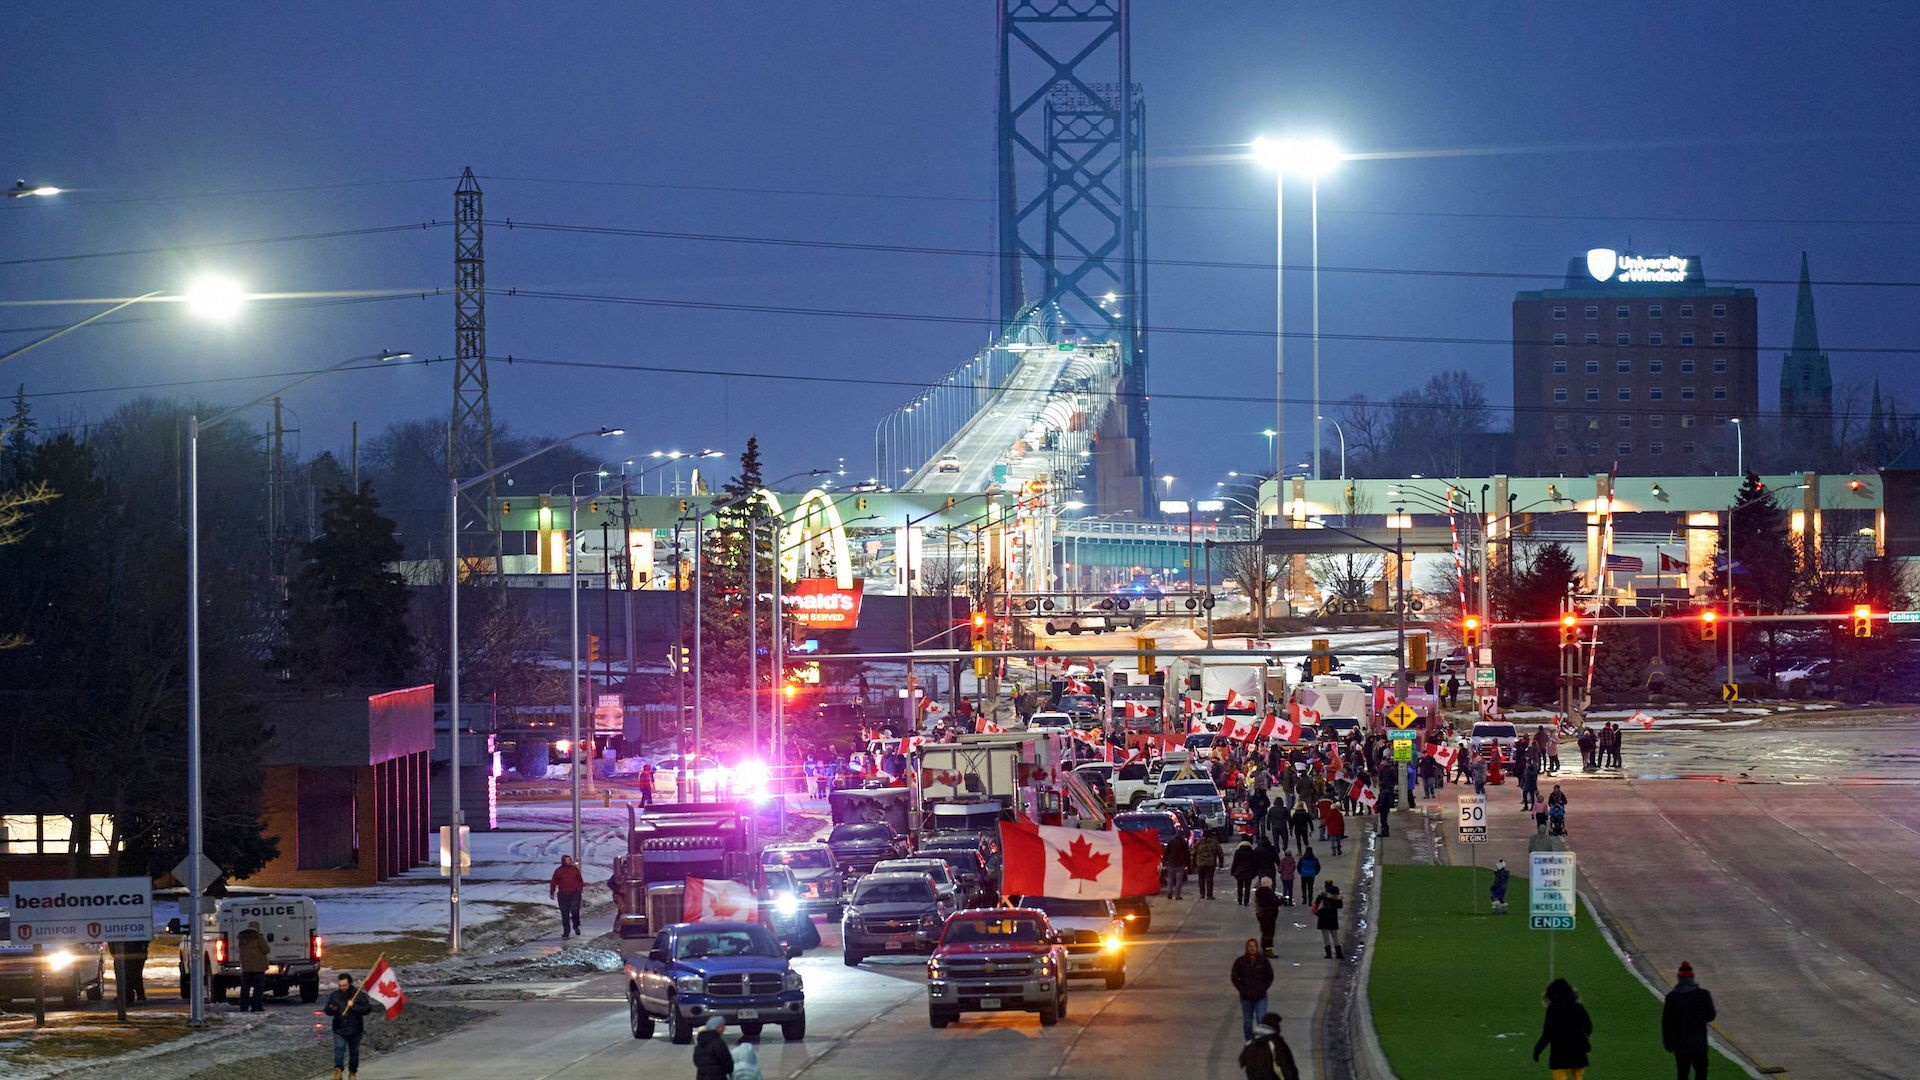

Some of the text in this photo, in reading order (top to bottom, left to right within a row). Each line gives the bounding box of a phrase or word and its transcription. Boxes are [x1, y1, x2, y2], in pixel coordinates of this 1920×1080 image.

[810, 613, 857, 622] SERVED
[1891, 613, 1920, 622] College
[1462, 806, 1483, 821] 50
[1460, 834, 1487, 842] BEGINS
[1533, 856, 1573, 865] COMMUNITY
[1540, 868, 1565, 876] SAFETY
[1544, 880, 1561, 888] ZONE
[15, 892, 144, 909] beadonor.ca
[1543, 892, 1562, 900] FINES
[241, 906, 295, 917] POLICE
[1534, 917, 1571, 928] ENDS
[35, 926, 77, 936] UNIFOR
[104, 923, 145, 933] UNIFOR
